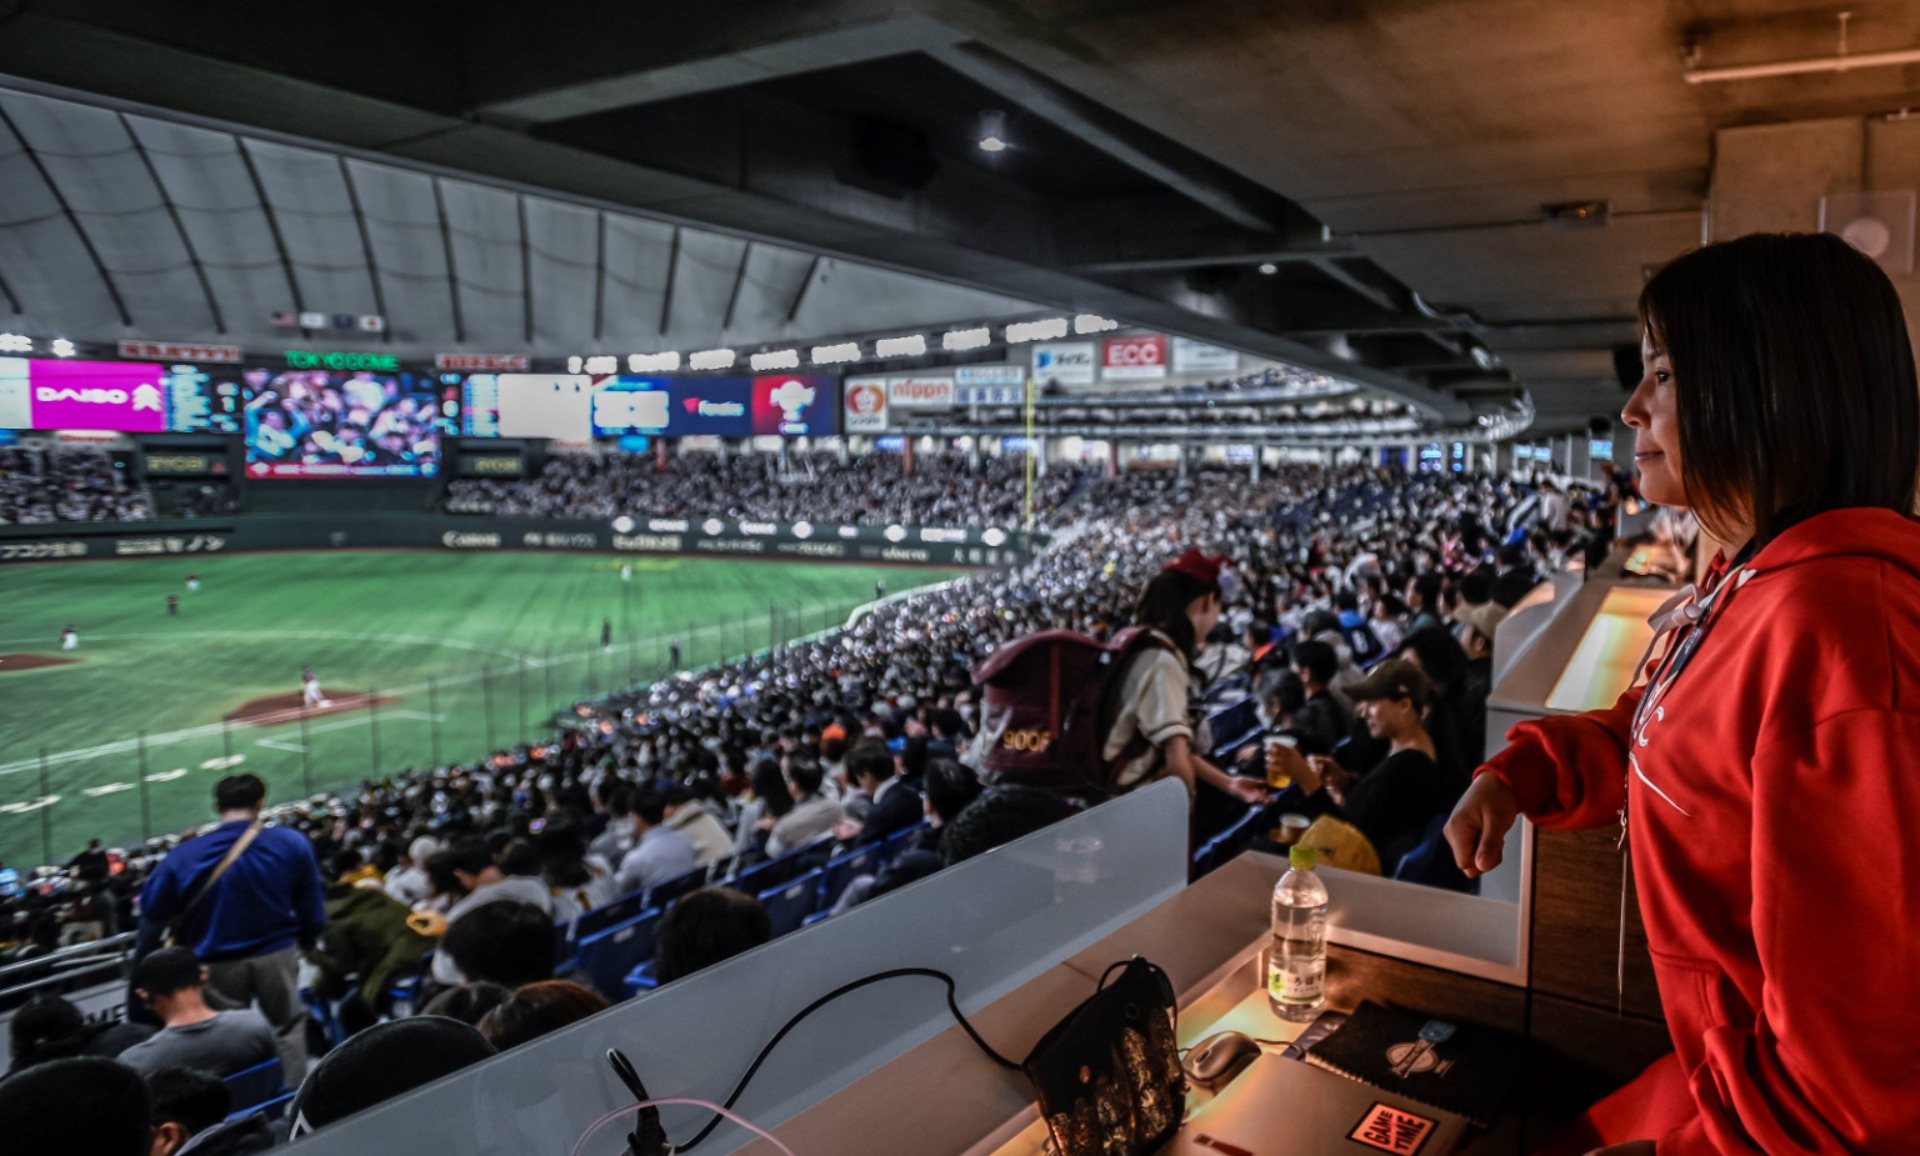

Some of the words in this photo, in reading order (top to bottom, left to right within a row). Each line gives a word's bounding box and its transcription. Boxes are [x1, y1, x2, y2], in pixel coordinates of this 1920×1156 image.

[284, 350, 346, 370] TOKYO
[346, 351, 399, 371] DOME
[1108, 344, 1160, 364] ECC
[892, 379, 950, 399] nippn
[1363, 1110, 1394, 1145] GAME
[1395, 1115, 1426, 1151] TIME
